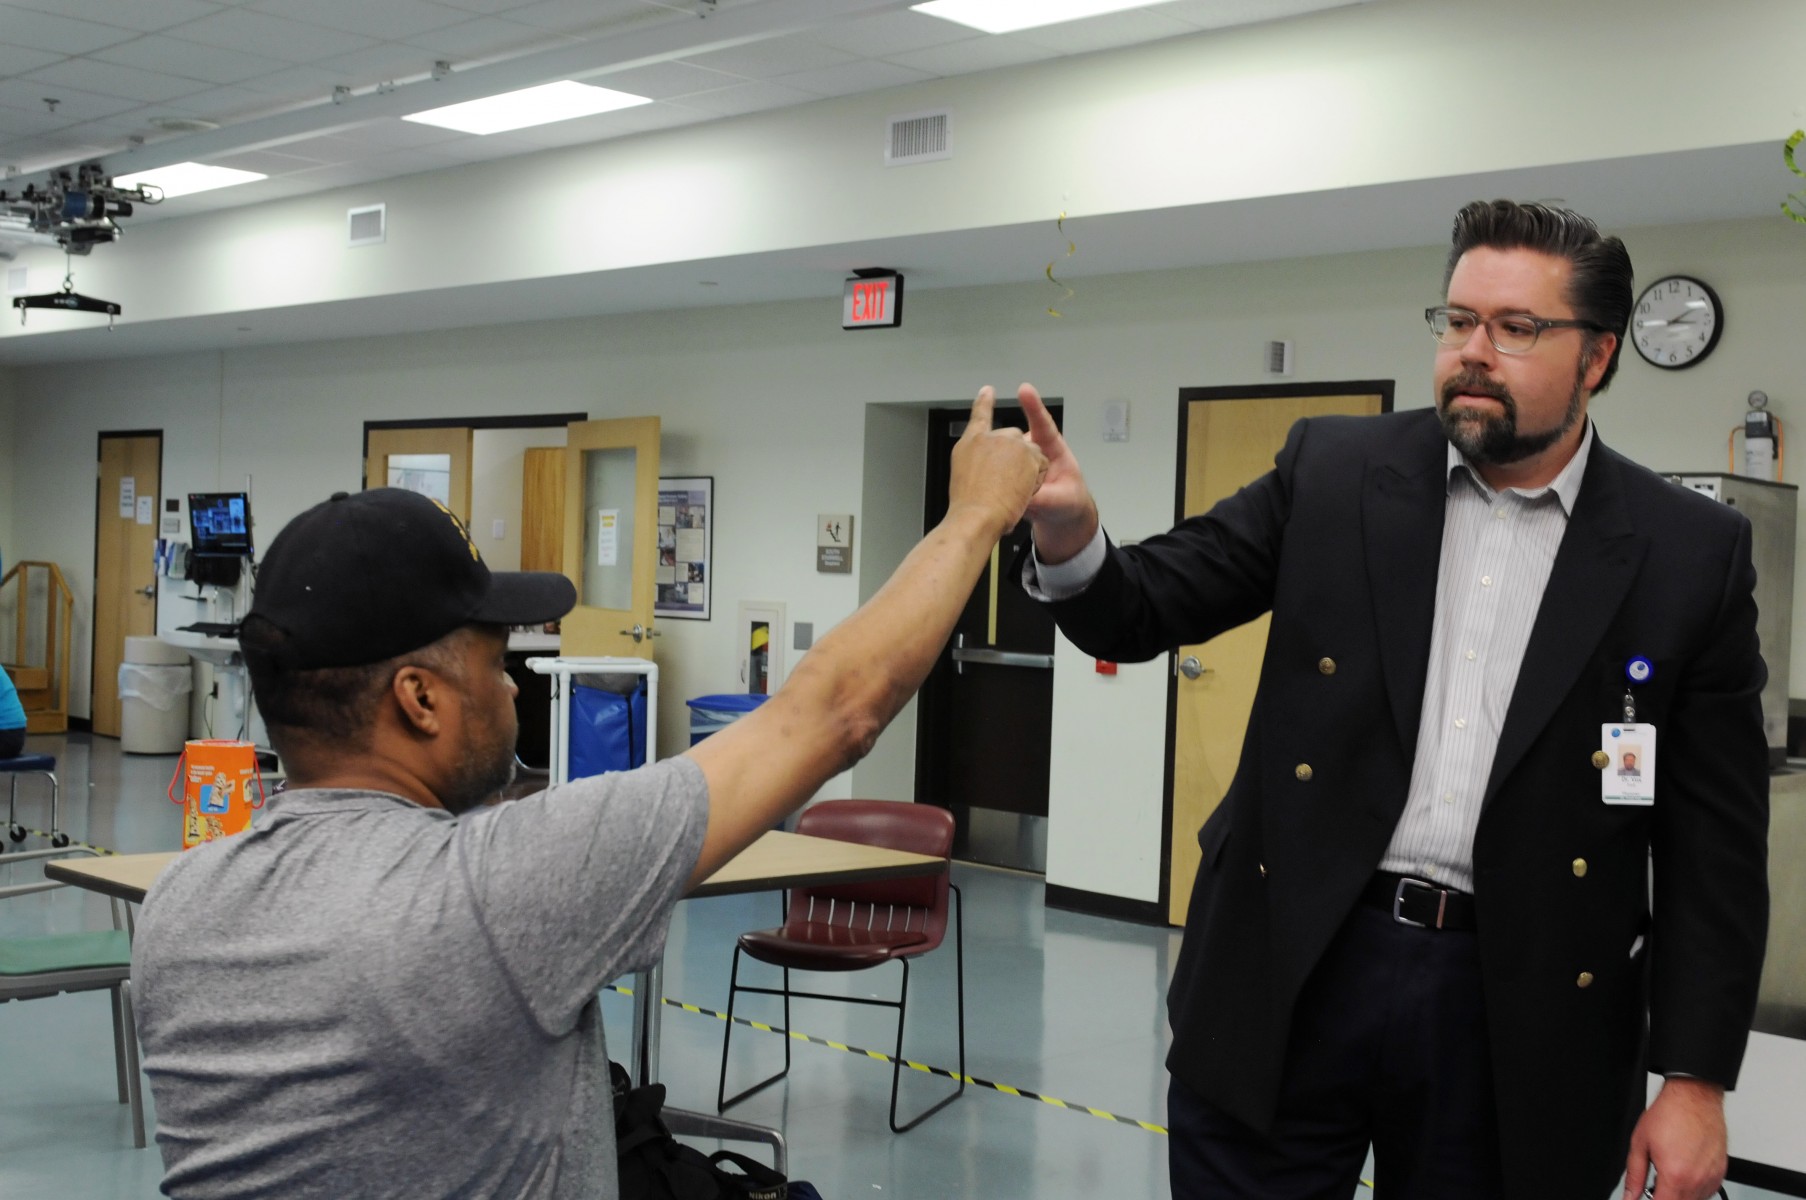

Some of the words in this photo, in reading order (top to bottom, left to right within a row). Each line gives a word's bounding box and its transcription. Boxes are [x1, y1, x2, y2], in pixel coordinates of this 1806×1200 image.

[1668, 280, 1680, 293] 12
[1687, 286, 1692, 297] 1
[1654, 290, 1663, 301] 11
[852, 282, 889, 322] EXIT
[1640, 302, 1651, 314] 10
[1699, 332, 1705, 342] 4
[1654, 348, 1662, 360] 7
[1669, 351, 1677, 363] 6
[1686, 345, 1693, 357] 5
[749, 1191, 777, 1200] Nikon
